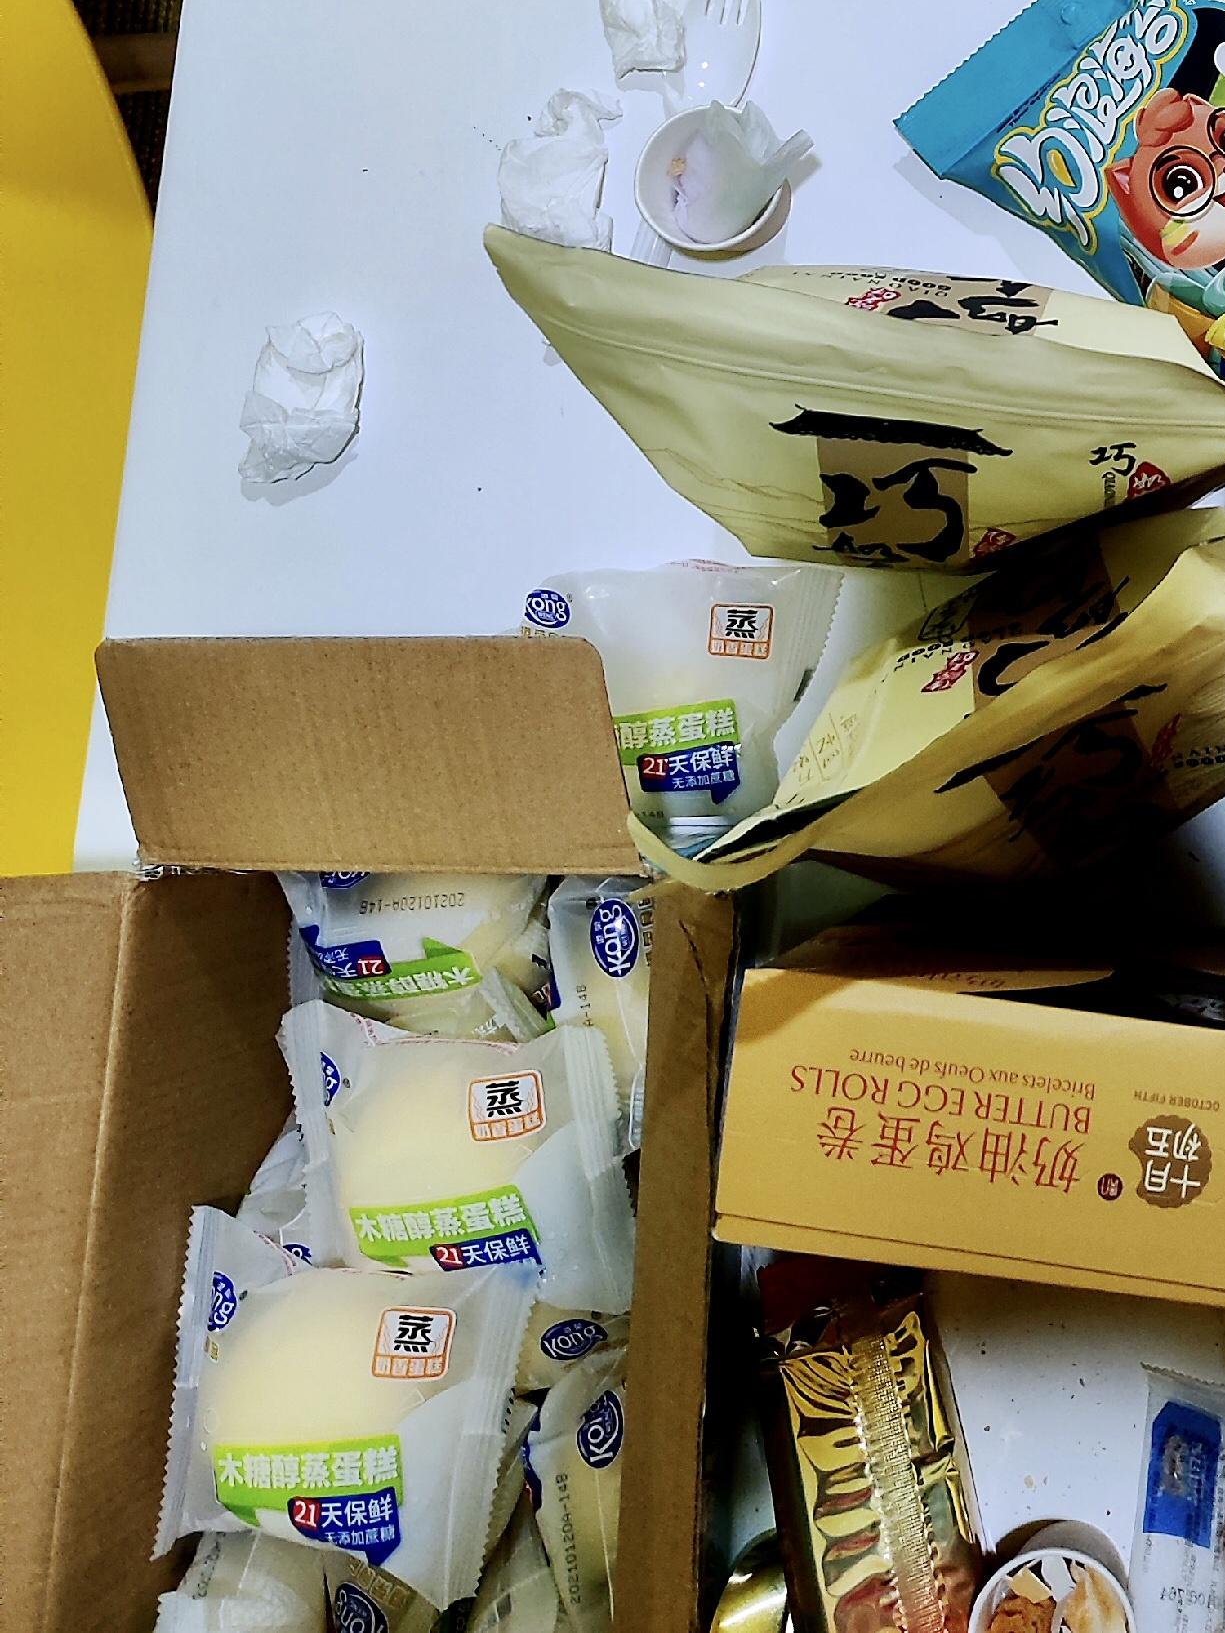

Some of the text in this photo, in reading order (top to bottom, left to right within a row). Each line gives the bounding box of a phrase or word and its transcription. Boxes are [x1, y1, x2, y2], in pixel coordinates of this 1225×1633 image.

[725, 609, 758, 639] 蒸
[616, 708, 735, 750] 醇蒸蛋糕
[642, 746, 735, 777] 21天保鲜
[672, 769, 735, 790] 无添加蔗糖
[359, 892, 466, 915] 20210120A-14B
[328, 967, 474, 997] 木糖醇蒸
[849, 1048, 1096, 1101] Bricelets aux Oeufs de beurre
[486, 1080, 523, 1117] 蒸
[790, 1064, 1091, 1134] BUTTER EGG ROLLS
[1133, 1089, 1220, 1112] OCTOBER FIFTH
[816, 1106, 1081, 1195] 奶油鸡蛋卷
[1144, 1123, 1202, 1163] 初五
[1143, 1164, 1201, 1200] 十月
[354, 1194, 527, 1242] 木糖醇蒸蛋糕
[434, 1234, 531, 1265] 21天保鲜
[396, 1314, 433, 1353] 蒸
[217, 1446, 398, 1490] 木糖醇蒸蛋糕
[293, 1497, 394, 1529] 21天保鲜
[554, 1471, 582, 1605] 20210120A-14B
